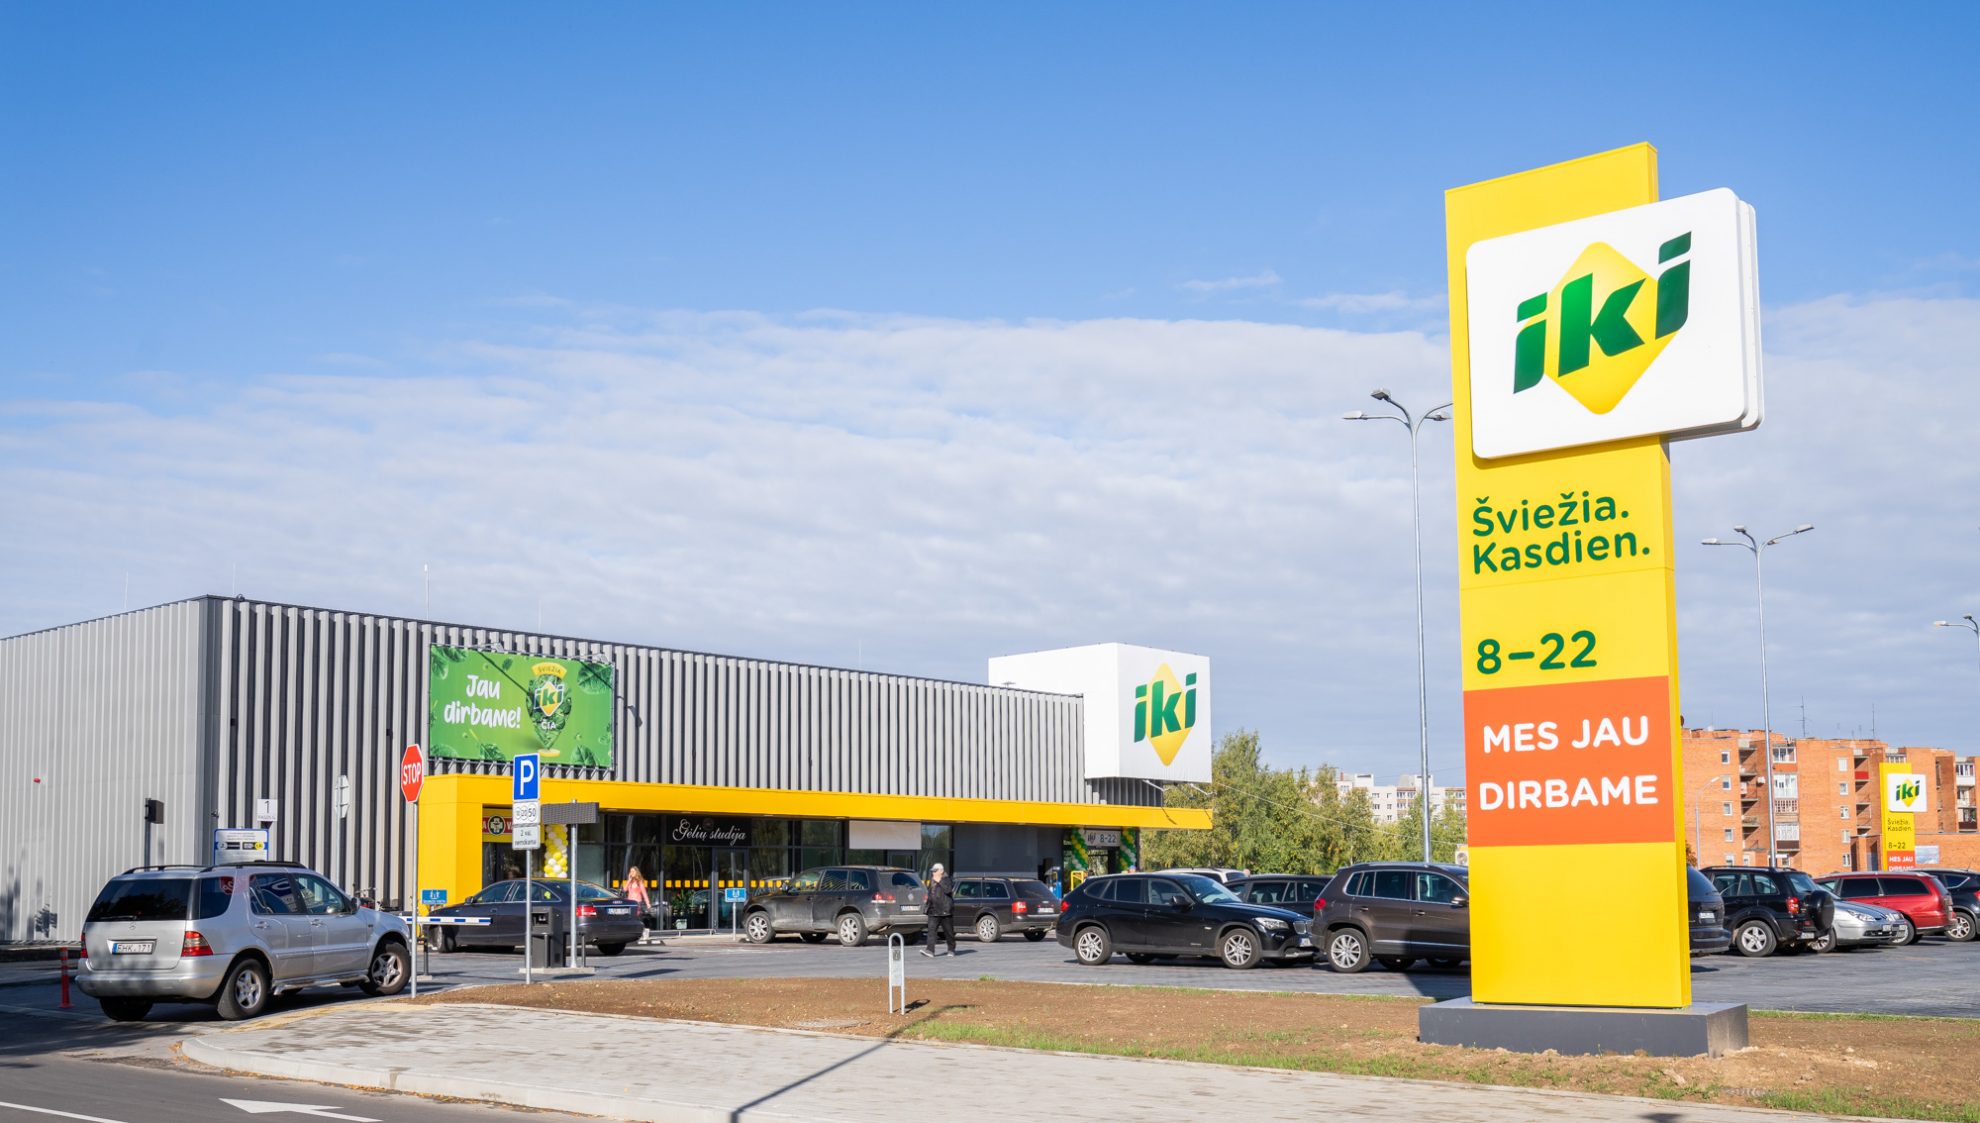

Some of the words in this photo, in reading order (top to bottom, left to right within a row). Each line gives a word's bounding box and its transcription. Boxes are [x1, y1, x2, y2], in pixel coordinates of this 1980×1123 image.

[1513, 231, 1692, 394] iki
[1472, 490, 1630, 538] Šviežia.
[1473, 530, 1651, 575] Kasdien.
[466, 674, 501, 700] Jau
[534, 682, 565, 710] iki
[444, 700, 521, 729] dirbame!
[1133, 671, 1197, 743] iki
[1483, 721, 1560, 754] MES
[1571, 715, 1649, 749] JAU
[403, 762, 422, 786] STOP
[520, 759, 534, 796] P
[1479, 774, 1659, 811] DIRBAME
[1895, 780, 1921, 802] iki
[528, 807, 537, 818] 50
[672, 818, 707, 842] Gėlių
[709, 825, 746, 847] studija
